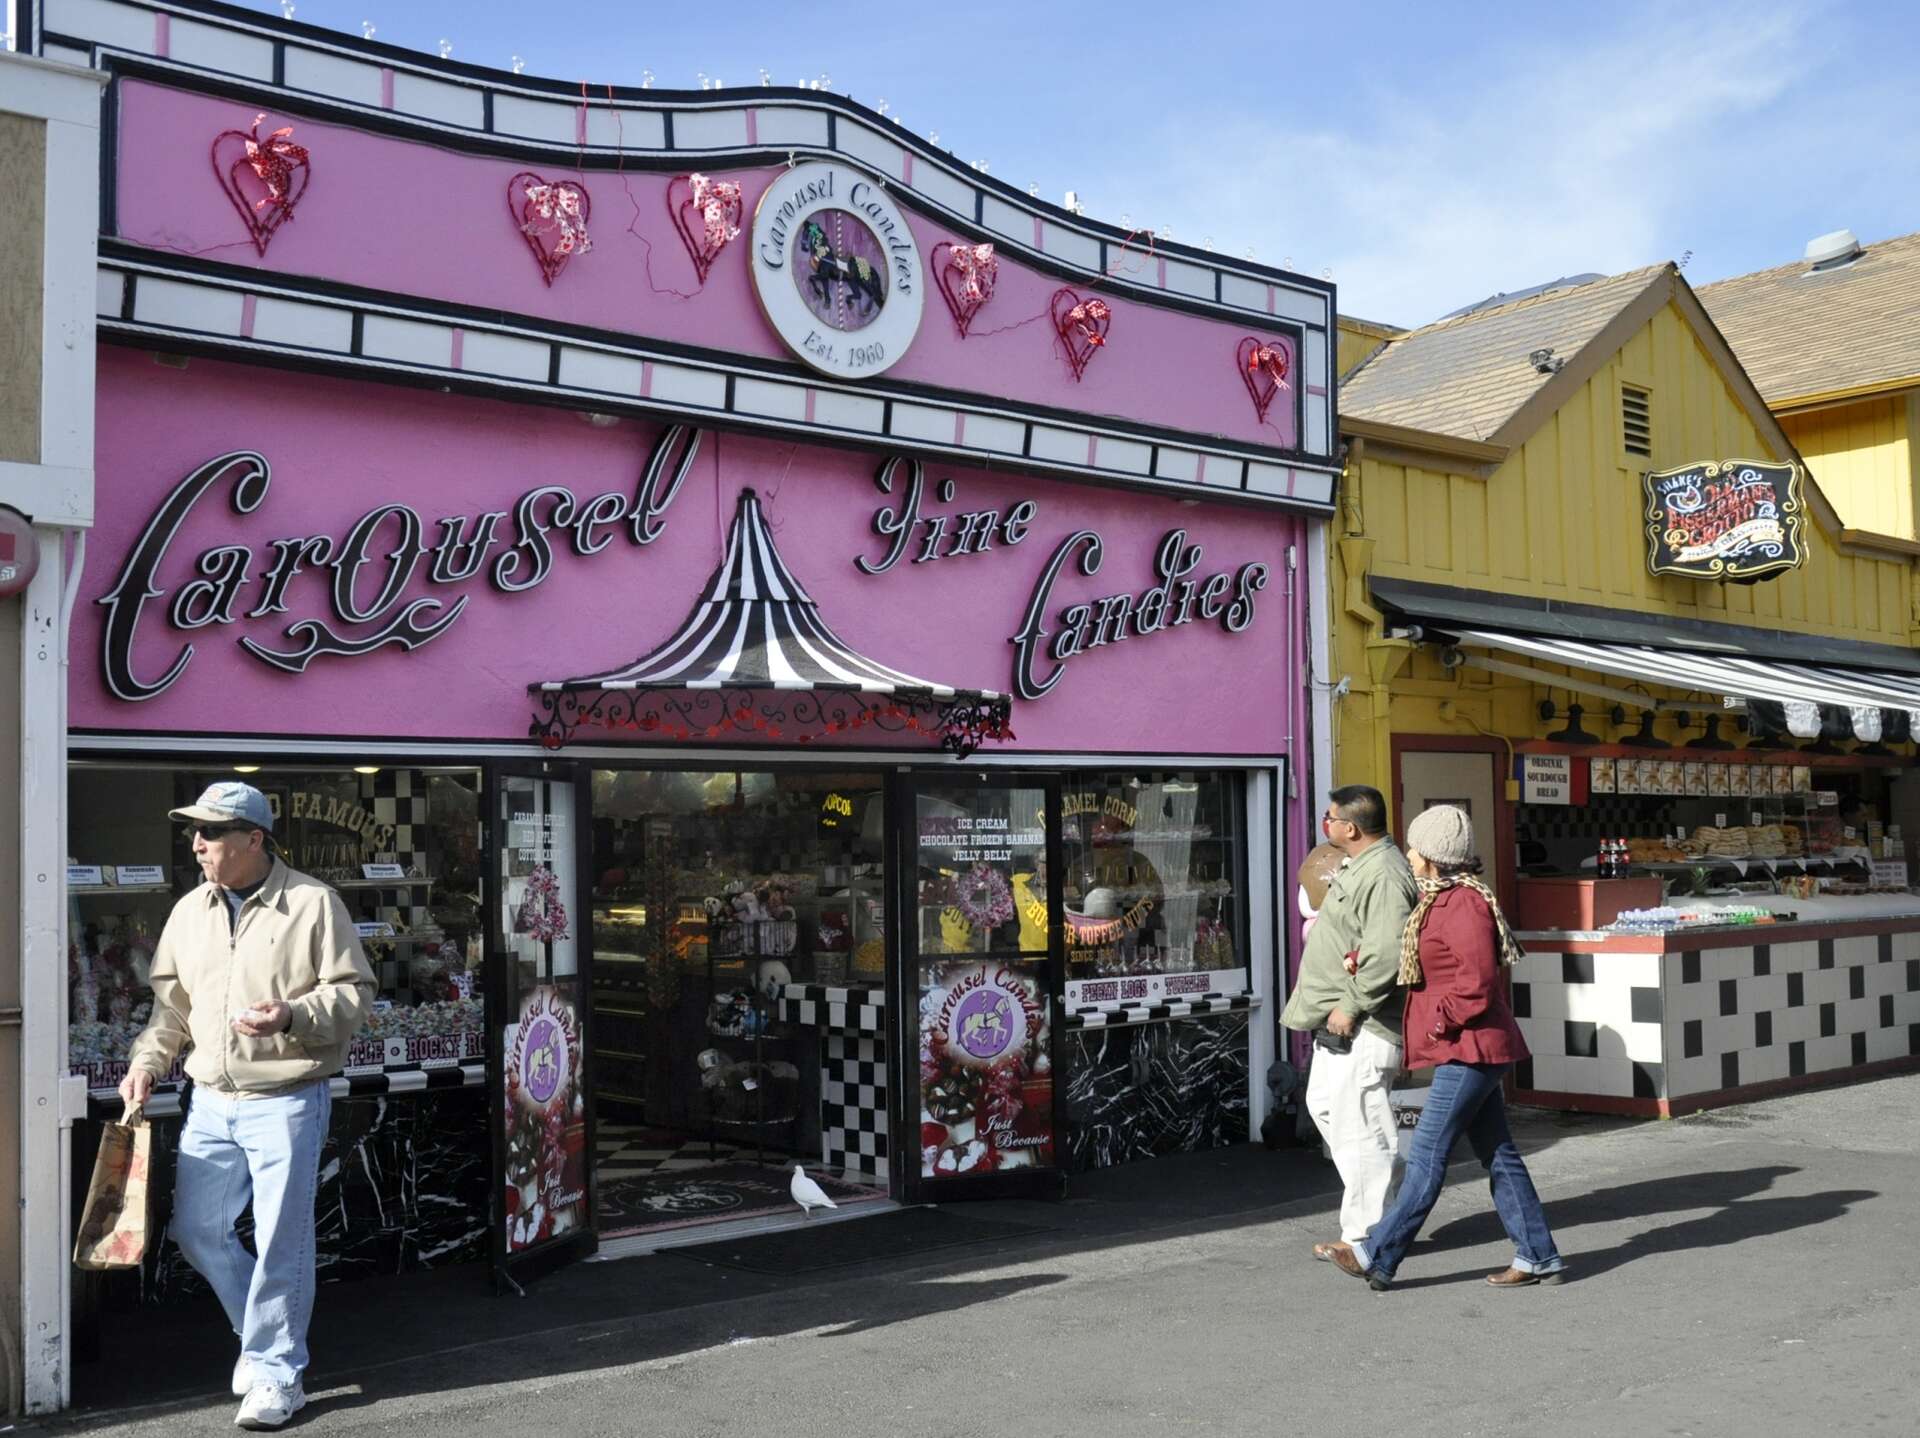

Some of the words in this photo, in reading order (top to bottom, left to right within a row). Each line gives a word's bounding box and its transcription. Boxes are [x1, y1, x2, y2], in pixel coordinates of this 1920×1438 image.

[761, 171, 834, 272] Carousel
[850, 182, 912, 296] Candies
[803, 331, 839, 365] Est.
[848, 342, 884, 367] 1960
[854, 456, 1038, 576] Fine
[1007, 528, 1270, 701] Candies
[292, 791, 395, 849] FAMOUS
[957, 818, 972, 829] ICE
[976, 818, 1008, 829] CREAM
[1104, 795, 1138, 826] CORN
[920, 834, 968, 847] CHOCOLATE
[971, 834, 1003, 846] FROZEN
[952, 850, 981, 861] JELLY
[984, 850, 1012, 861] BELLY
[1079, 919, 1124, 946] TOFFEE
[1121, 979, 1148, 999] LOGS
[1165, 973, 1211, 996] TURTLES
[407, 1035, 462, 1061] ROCKY
[980, 1113, 1013, 1136] Just
[994, 1130, 1050, 1149] Because
